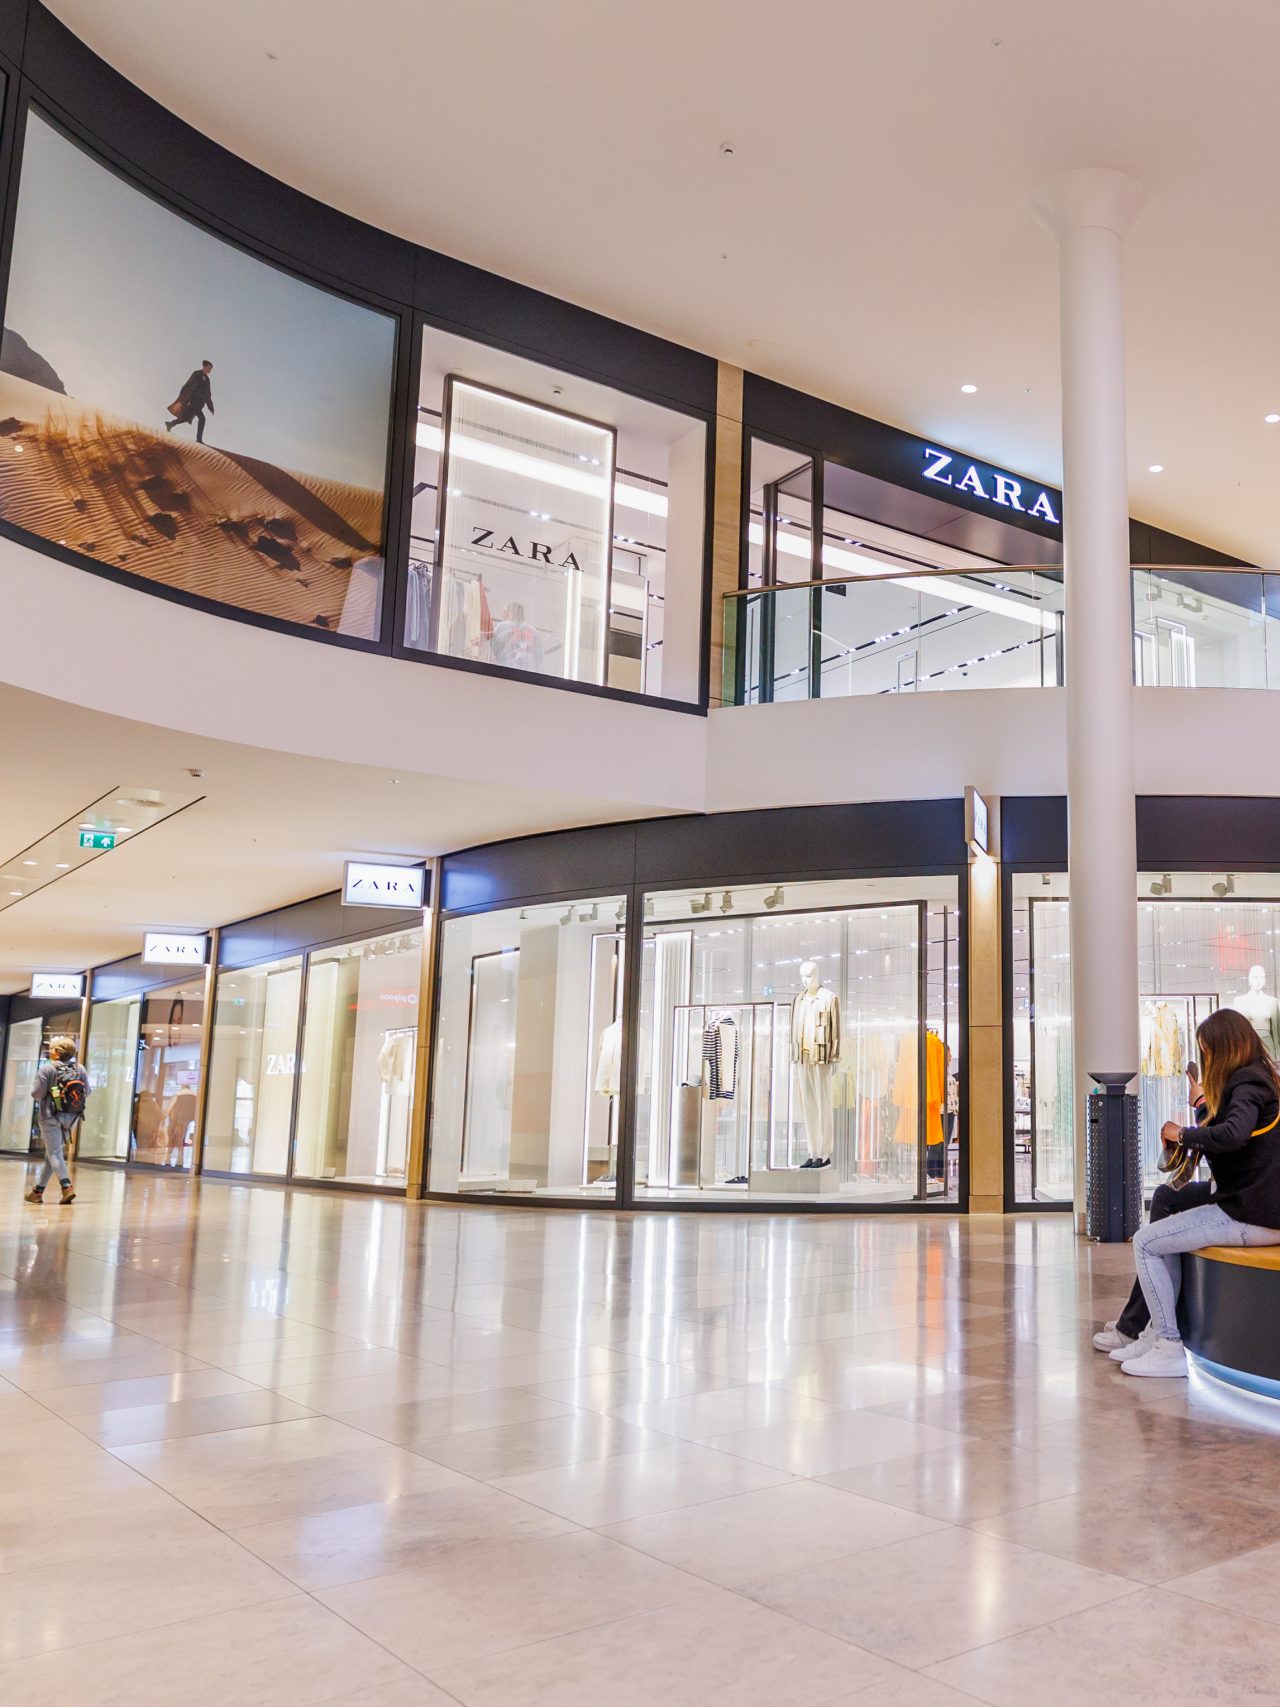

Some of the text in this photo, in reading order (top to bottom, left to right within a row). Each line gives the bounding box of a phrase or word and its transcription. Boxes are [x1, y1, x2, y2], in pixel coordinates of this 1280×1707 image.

[922, 447, 1060, 524] ZARA
[470, 526, 584, 573] ZARA
[352, 879, 415, 893] ZARA
[149, 945, 199, 954] ZARA
